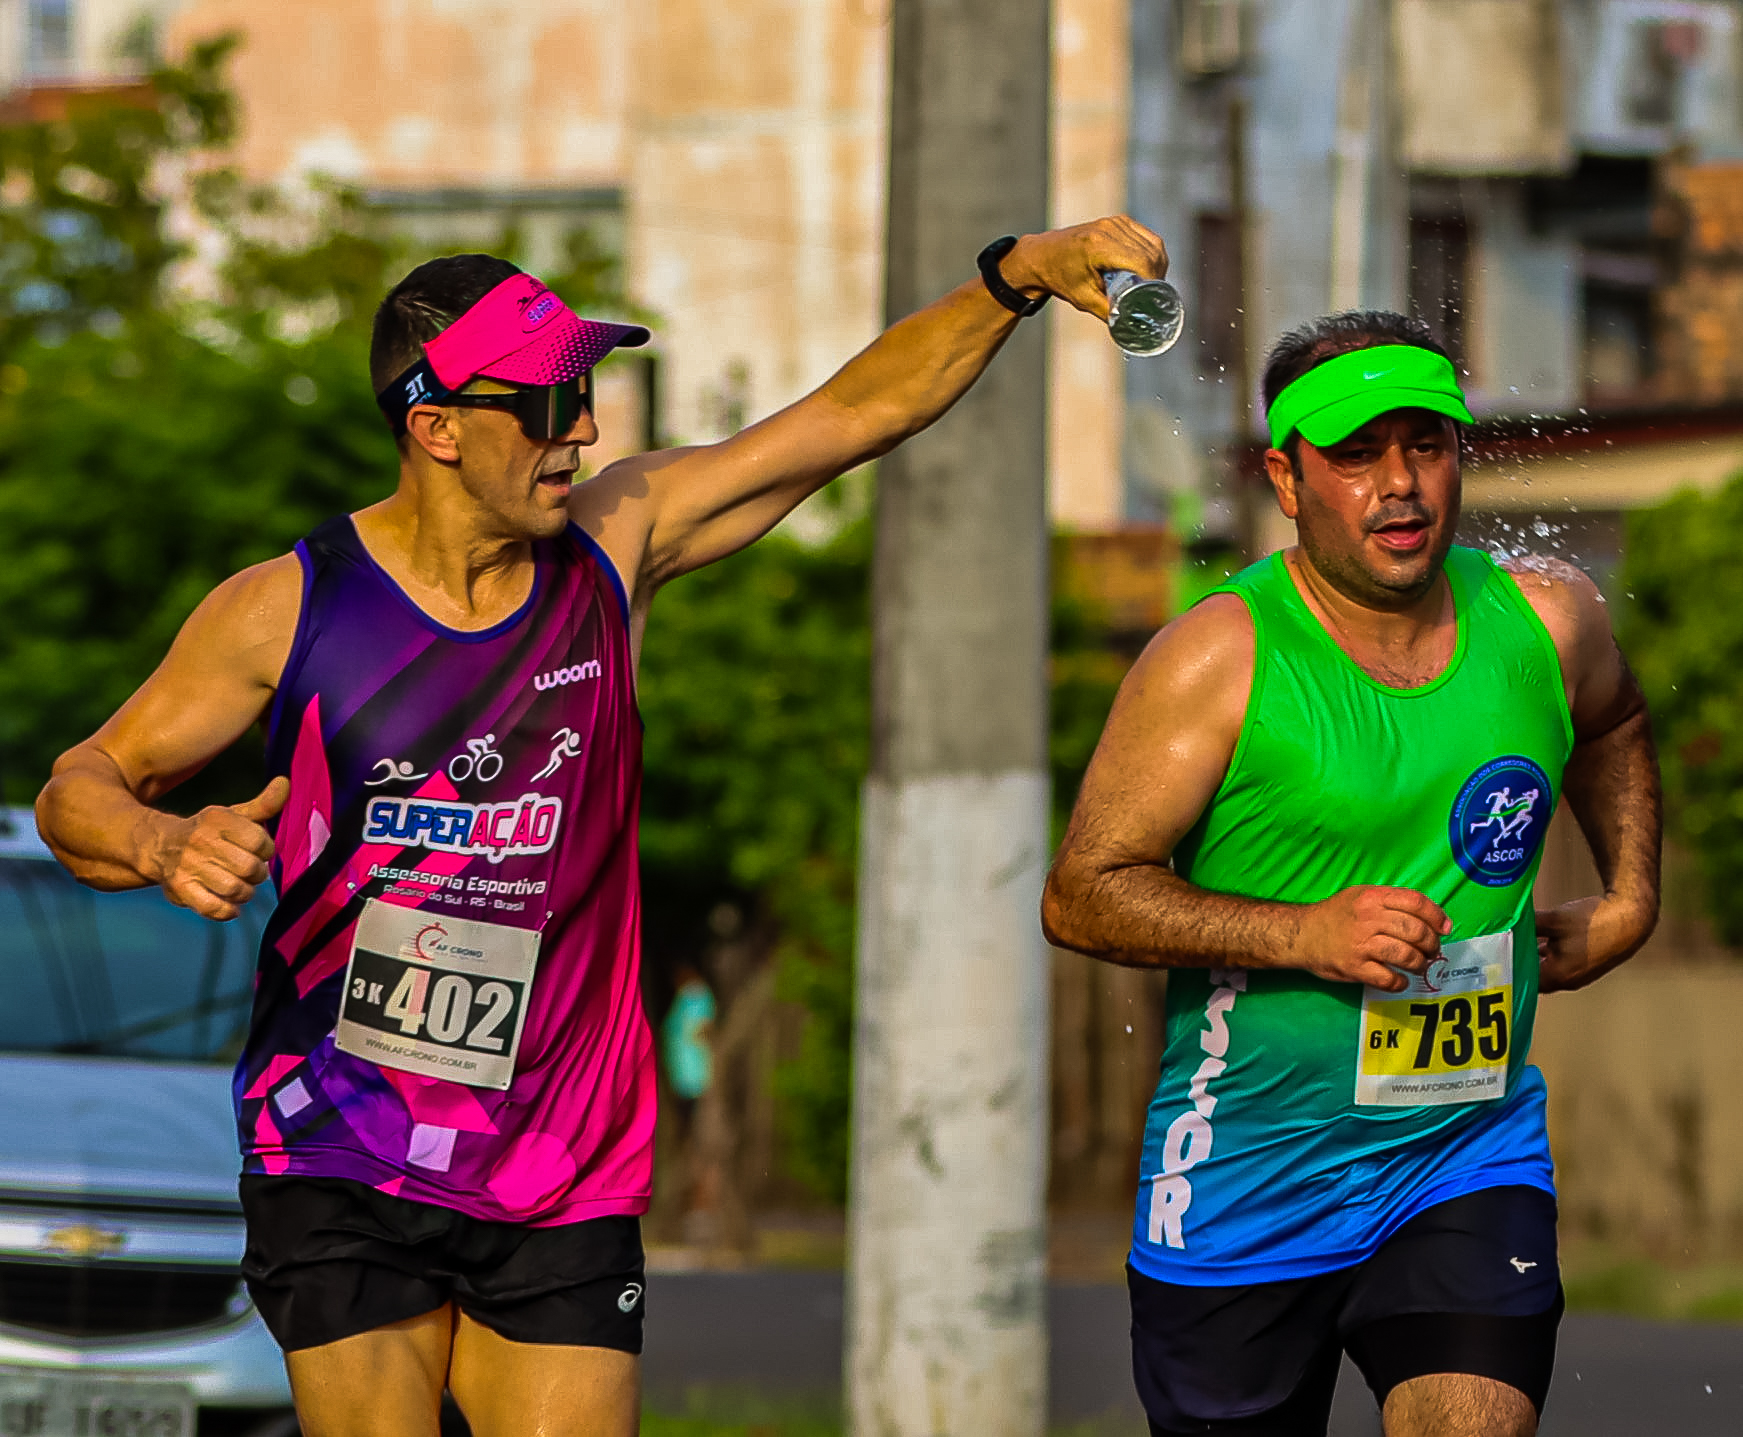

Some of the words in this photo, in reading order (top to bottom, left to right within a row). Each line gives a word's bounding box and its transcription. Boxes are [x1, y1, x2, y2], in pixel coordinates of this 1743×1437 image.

[533, 659, 602, 691] woom
[367, 799, 558, 856] SUPERAÇÃO
[1482, 847, 1524, 864] ASCOR
[367, 863, 465, 891] Assessoria
[466, 876, 547, 896] Esportiva
[428, 891, 442, 902] do
[444, 893, 463, 905] Sul
[469, 896, 487, 908] RS
[493, 898, 525, 912] Brasil
[1451, 966, 1480, 978] CRONO
[383, 966, 515, 1051] 402
[1410, 991, 1508, 1069] 735
[365, 1038, 478, 1071] WWW.AFCRONO.COM.BR
[1391, 1075, 1498, 1094] WWW.AFCRONO.COM.BR
